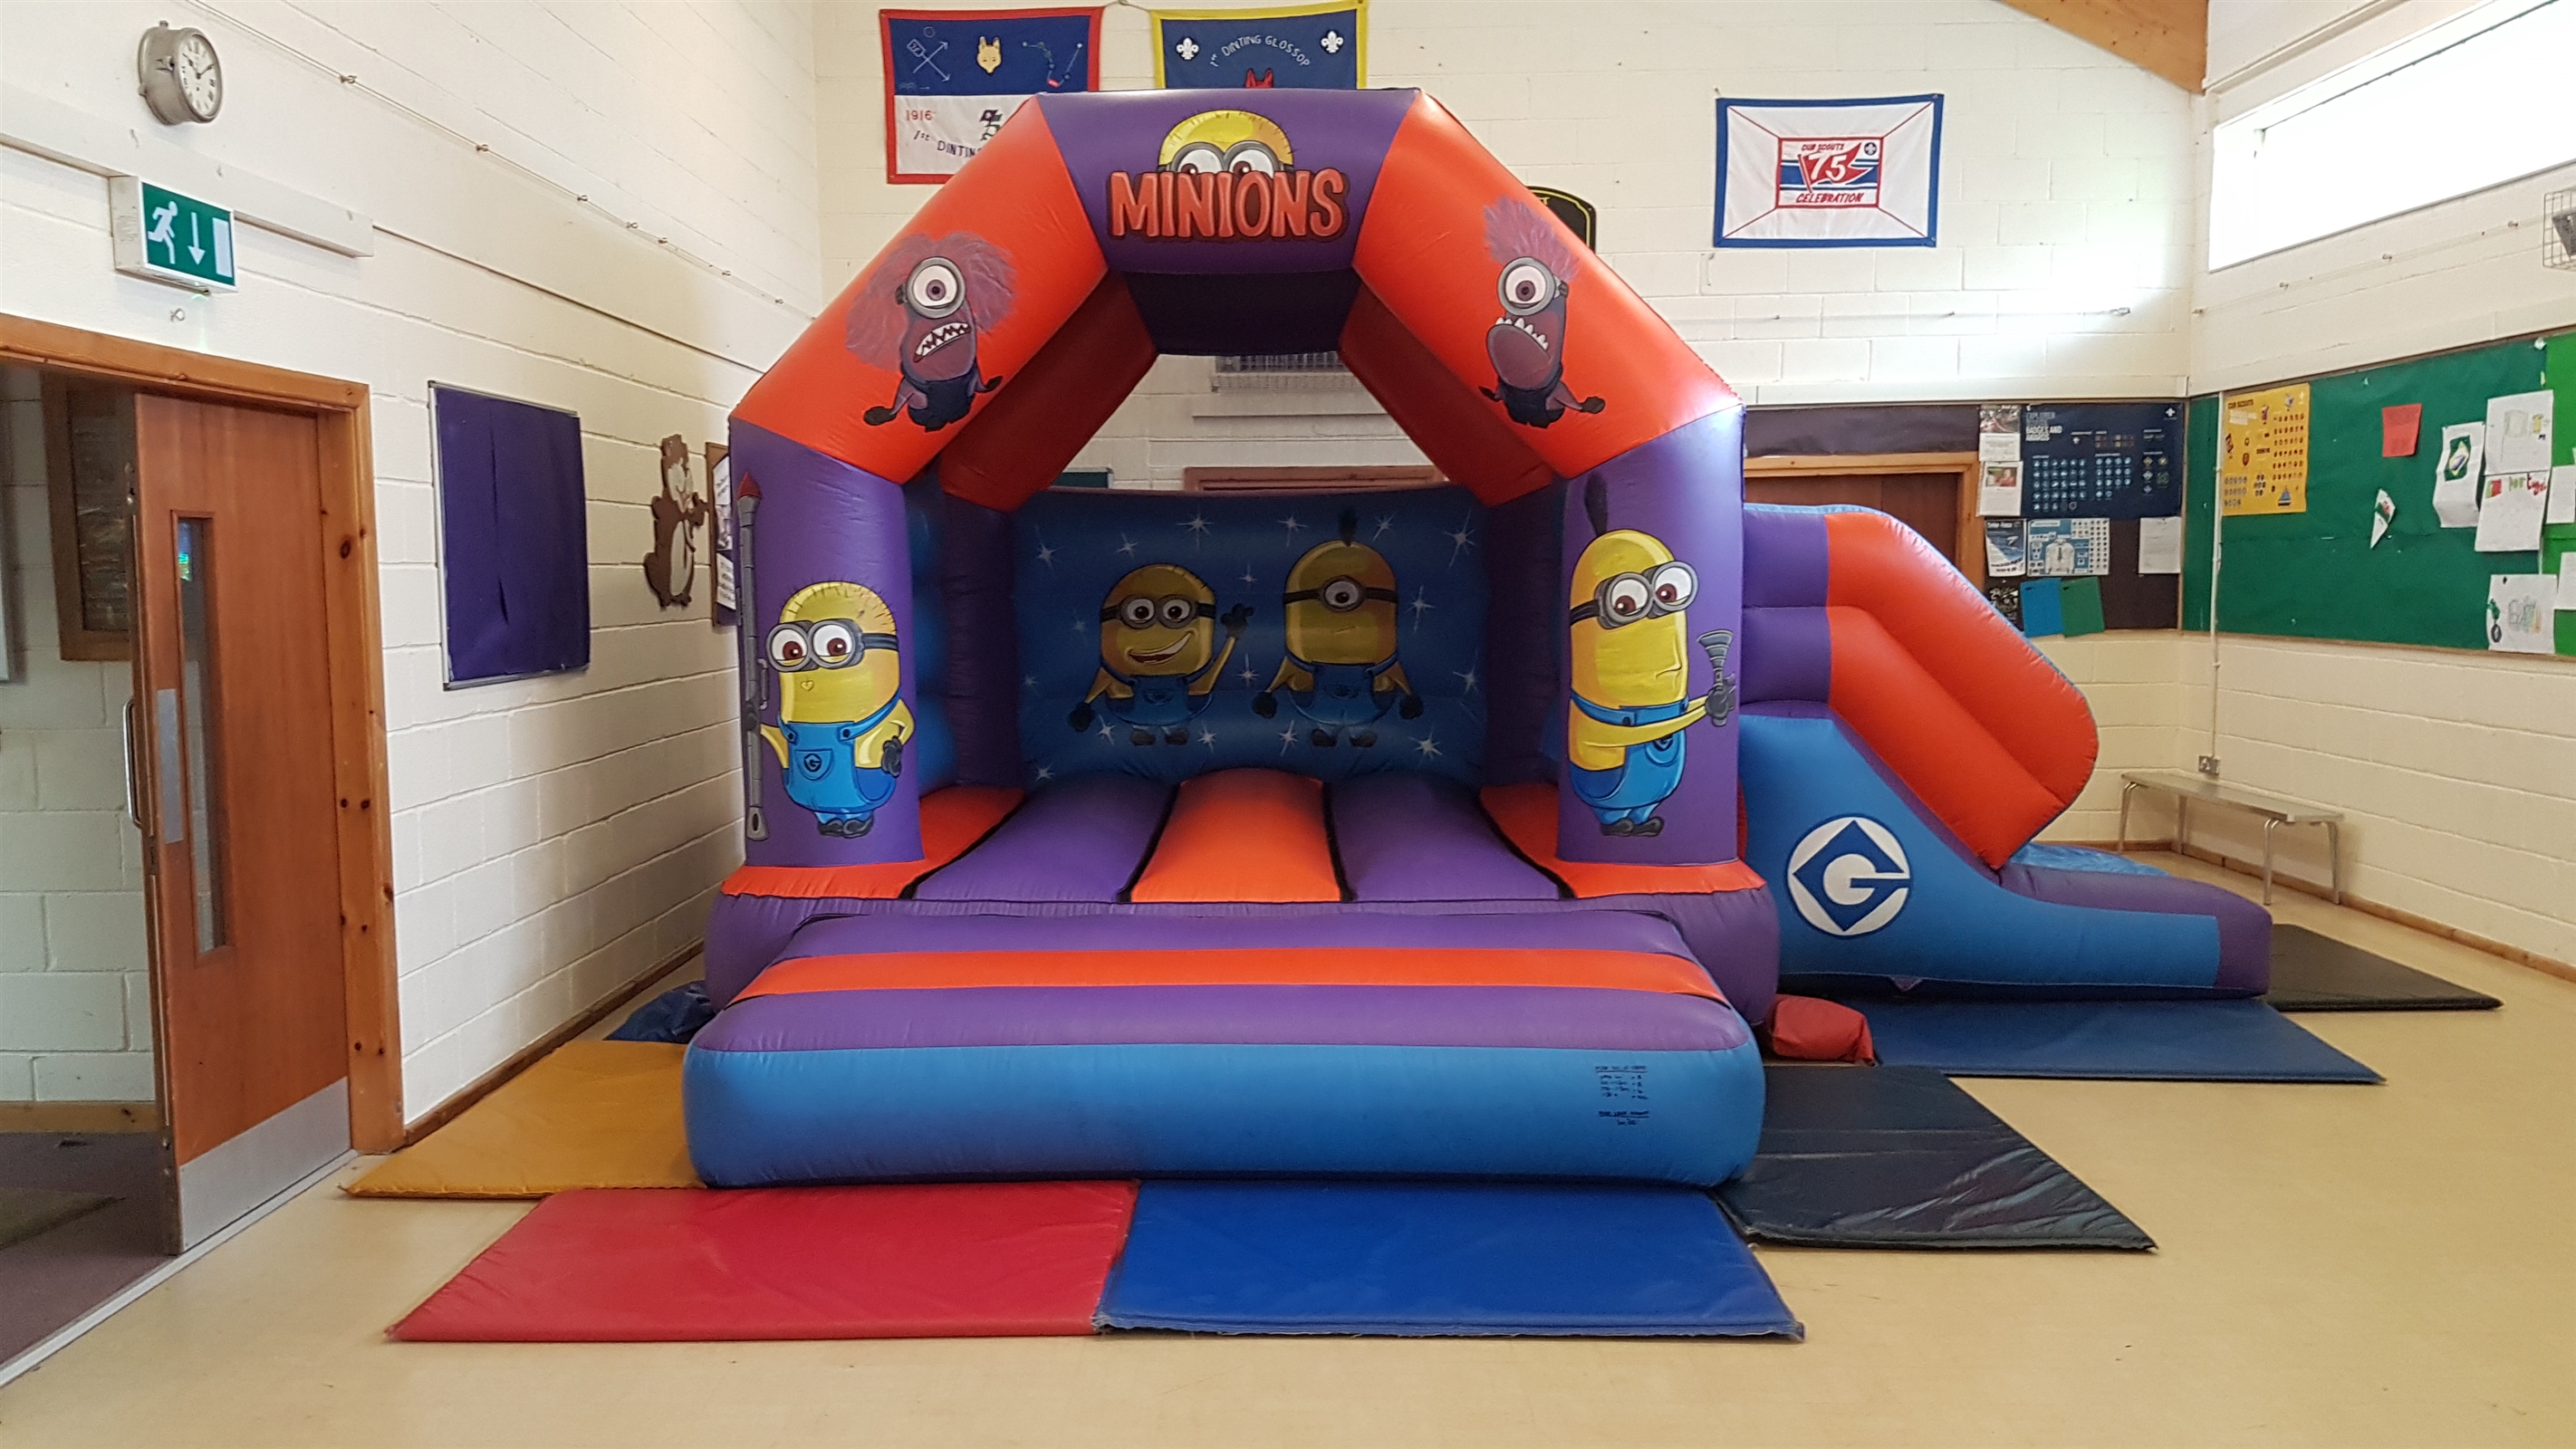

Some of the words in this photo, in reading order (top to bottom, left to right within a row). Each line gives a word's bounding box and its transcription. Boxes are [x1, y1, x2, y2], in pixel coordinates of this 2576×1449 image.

[1221, 34, 1262, 56] DINTING
[1264, 35, 1311, 66] GLOSSOP
[906, 110, 934, 121] 1916
[1808, 152, 1848, 181] 75
[1110, 168, 1345, 238] MINIONS
[1795, 192, 1864, 204] CELEBRATION
